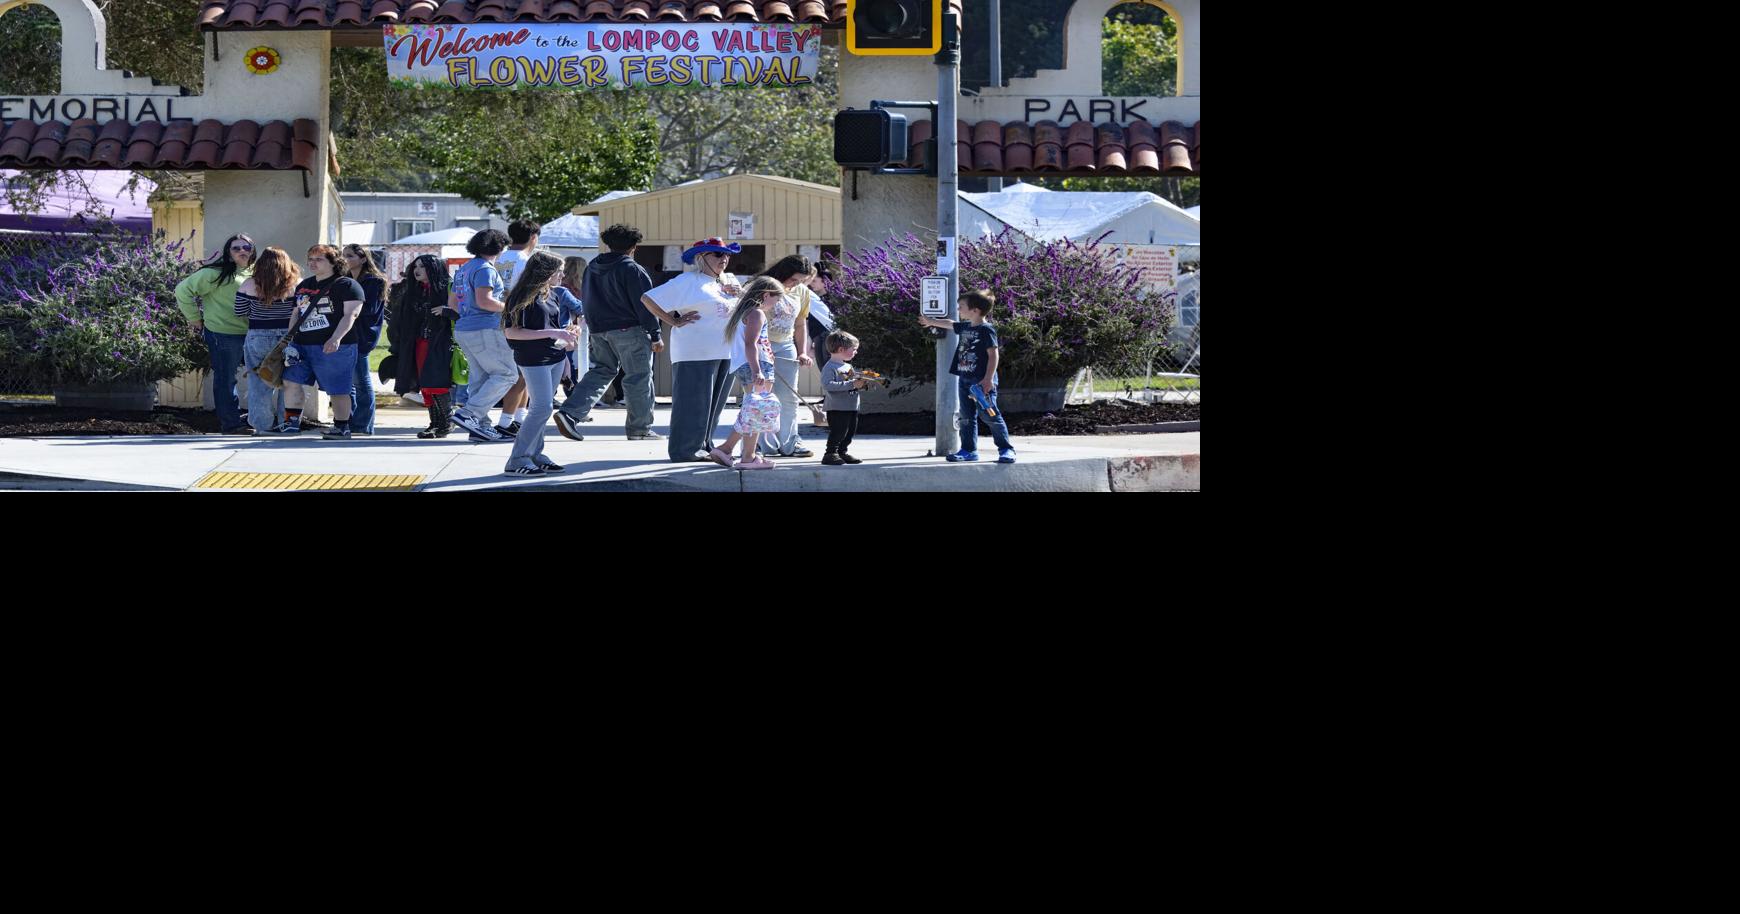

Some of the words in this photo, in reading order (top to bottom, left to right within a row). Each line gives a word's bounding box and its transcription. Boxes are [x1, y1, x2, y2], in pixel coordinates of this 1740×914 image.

[390, 28, 532, 69] Welcome
[532, 36, 549, 48] to
[553, 34, 579, 48] the
[586, 29, 699, 53] LOMPOC
[712, 30, 811, 53] VALLEY
[446, 54, 611, 88] FLOWER
[621, 54, 813, 88] FESTIVAL
[1024, 98, 1148, 122] PARK
